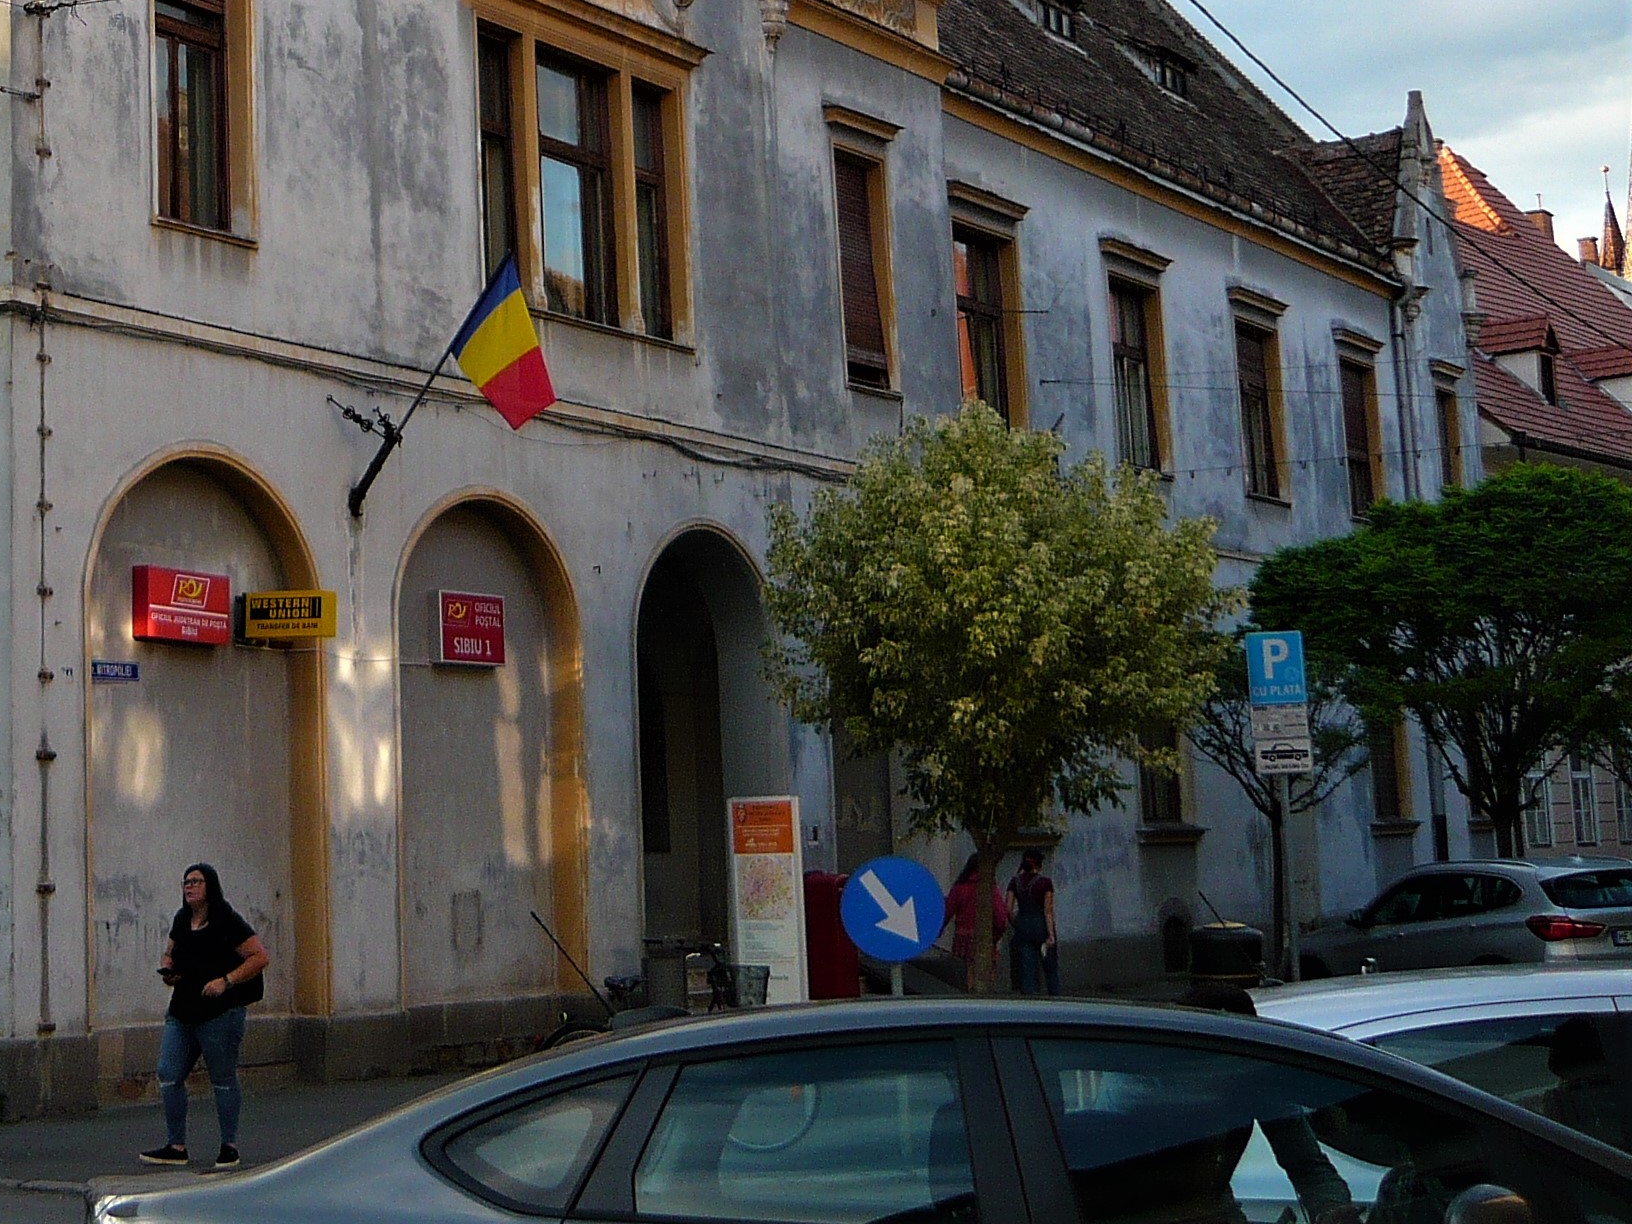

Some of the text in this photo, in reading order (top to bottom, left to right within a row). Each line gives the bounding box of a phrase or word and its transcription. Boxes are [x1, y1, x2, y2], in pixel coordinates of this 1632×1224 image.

[251, 597, 310, 609] WESTERN
[474, 602, 501, 615] OFICIUL
[269, 608, 310, 618] UNION
[257, 622, 290, 631] TRANSFER
[291, 622, 301, 630] DE
[453, 636, 492, 655] SIBIU 1
[1262, 638, 1289, 680] P
[1252, 685, 1267, 697] CU
